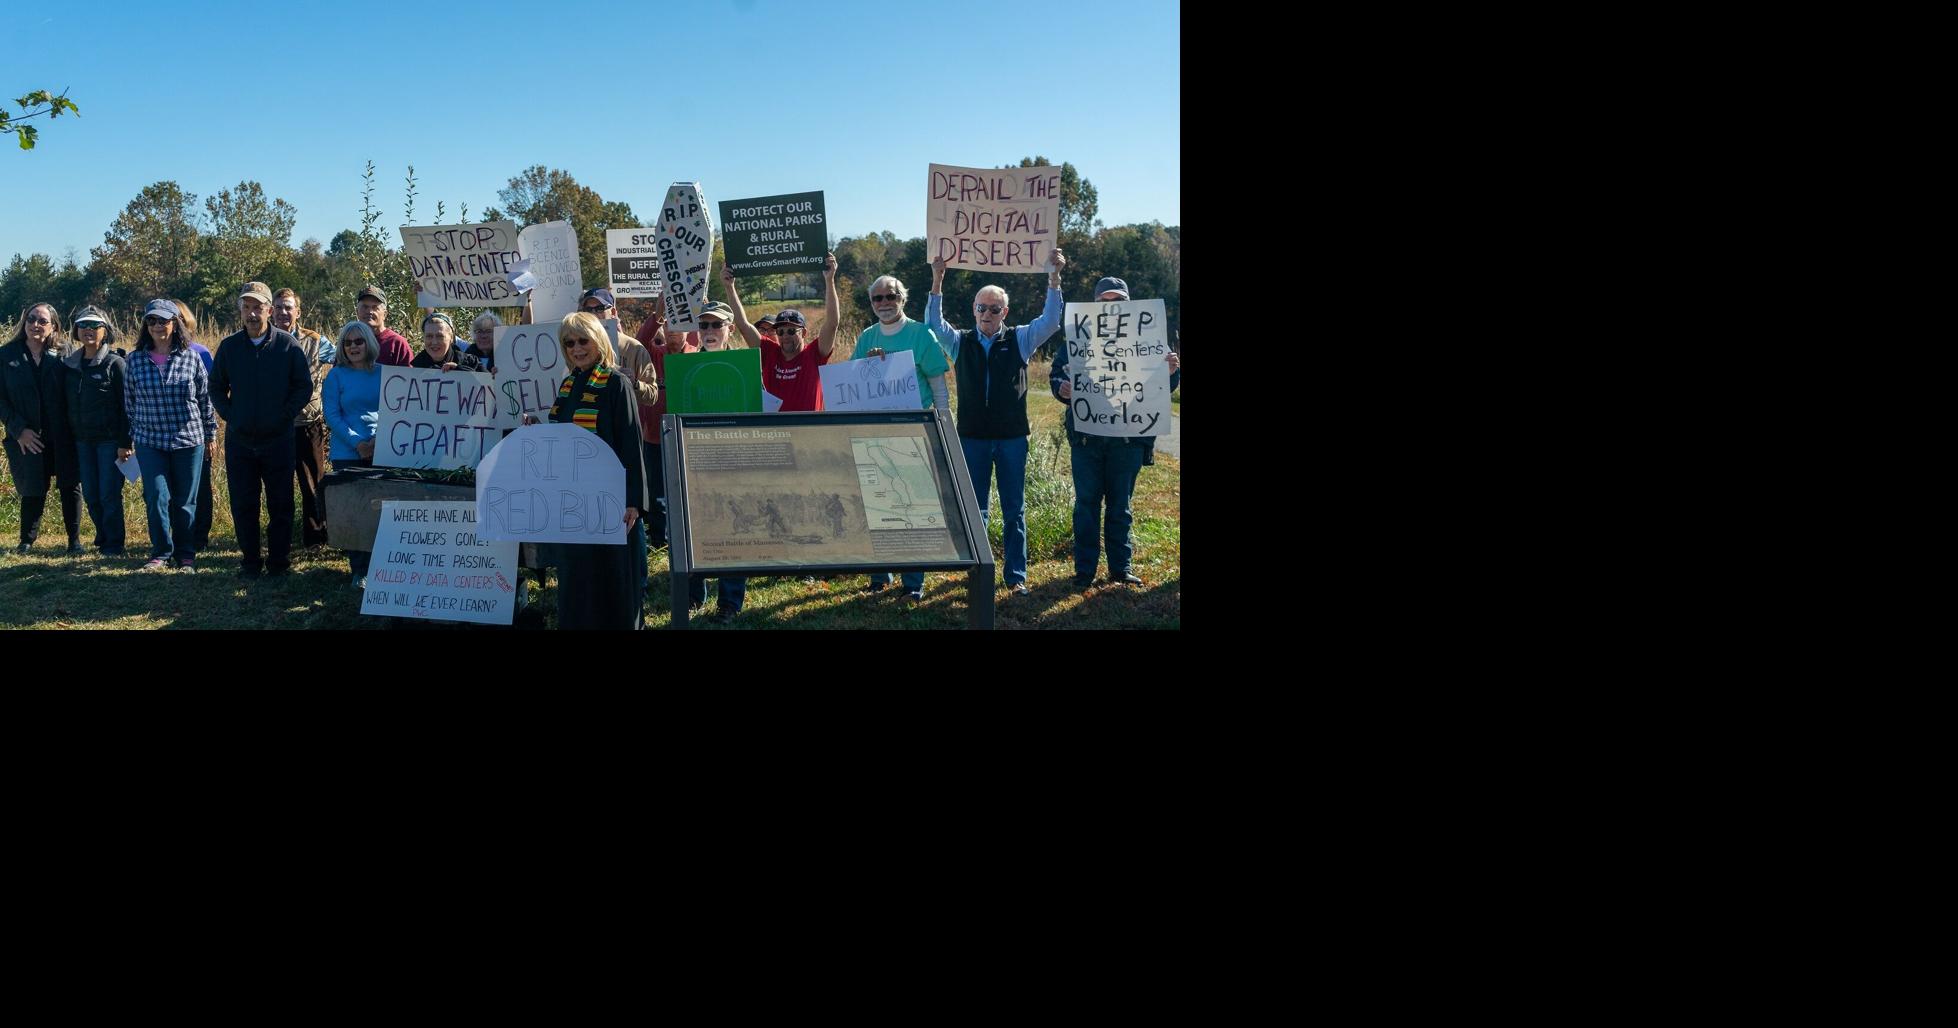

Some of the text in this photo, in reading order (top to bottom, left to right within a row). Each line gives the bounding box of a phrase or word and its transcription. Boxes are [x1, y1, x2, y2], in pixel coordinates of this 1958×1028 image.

[933, 171, 1060, 202] DERAIL THE
[732, 201, 813, 219] PROTECT OUR
[724, 213, 823, 233] NATIONAL PARKS
[954, 210, 1048, 236] DIGITAL
[434, 227, 495, 252] STOP
[631, 234, 656, 246] STO
[675, 225, 706, 252] OUR
[749, 229, 800, 243] & RURAL
[616, 247, 656, 255] INDUSTRIAL
[746, 241, 805, 256] CRESCENT
[938, 237, 1041, 266] DESERT
[408, 255, 456, 278] DATA
[731, 256, 823, 270] www.GrowSmartPW.org
[539, 275, 576, 289] ROUND
[658, 237, 693, 324] CRESCENT
[1074, 311, 1153, 340] KEEP
[511, 332, 558, 373] GO
[1068, 340, 1095, 358] Data
[1107, 360, 1127, 372] in
[383, 374, 498, 420] GATEWAY
[835, 375, 916, 405] IN LOVING
[1073, 397, 1160, 435] Overlay
[390, 420, 496, 461] GRAFT
[687, 429, 792, 441] The Battle Begins
[393, 508, 477, 523] WHERE HAVE ALL
[484, 486, 623, 535] RED BUD
[399, 530, 447, 547] FLOWERS
[387, 551, 416, 565] LONG
[421, 553, 446, 568] TIME
[374, 568, 407, 584] KILLED
[410, 571, 422, 585] BY
[426, 573, 449, 587] DATA
[453, 575, 495, 590] CENTERS
[366, 591, 390, 605] WHEN
[394, 592, 411, 608] WILL
[430, 596, 458, 611] EVER
[459, 598, 498, 613] LEARN?
